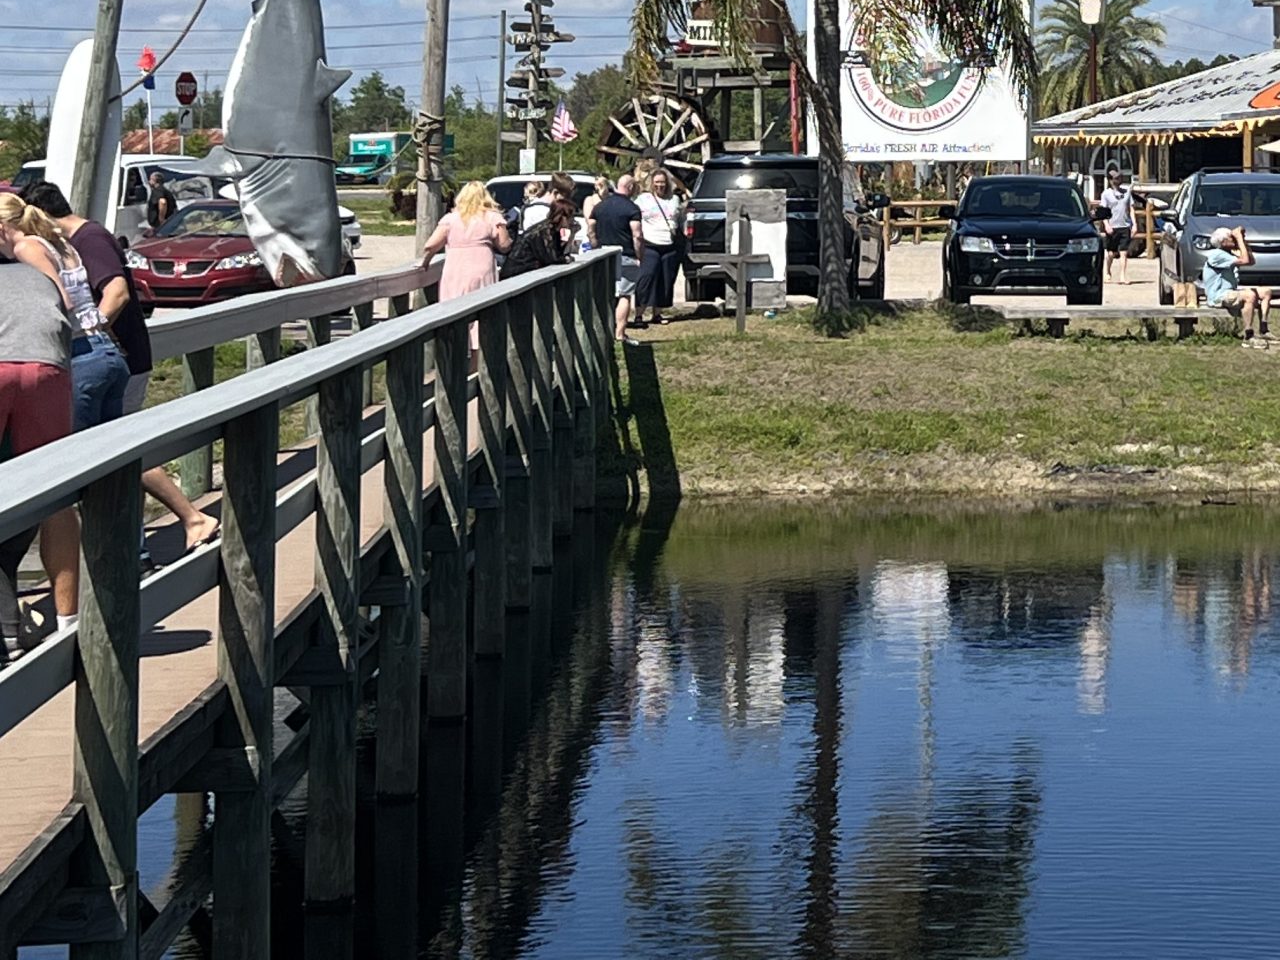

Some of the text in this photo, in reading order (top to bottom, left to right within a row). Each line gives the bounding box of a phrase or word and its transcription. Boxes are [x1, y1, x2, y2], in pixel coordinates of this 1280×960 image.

[177, 83, 196, 95] STOP
[873, 99, 906, 123] PURE
[908, 98, 961, 124] FLORIDA
[884, 143, 917, 153] FRESH
[919, 143, 938, 153] AIR
